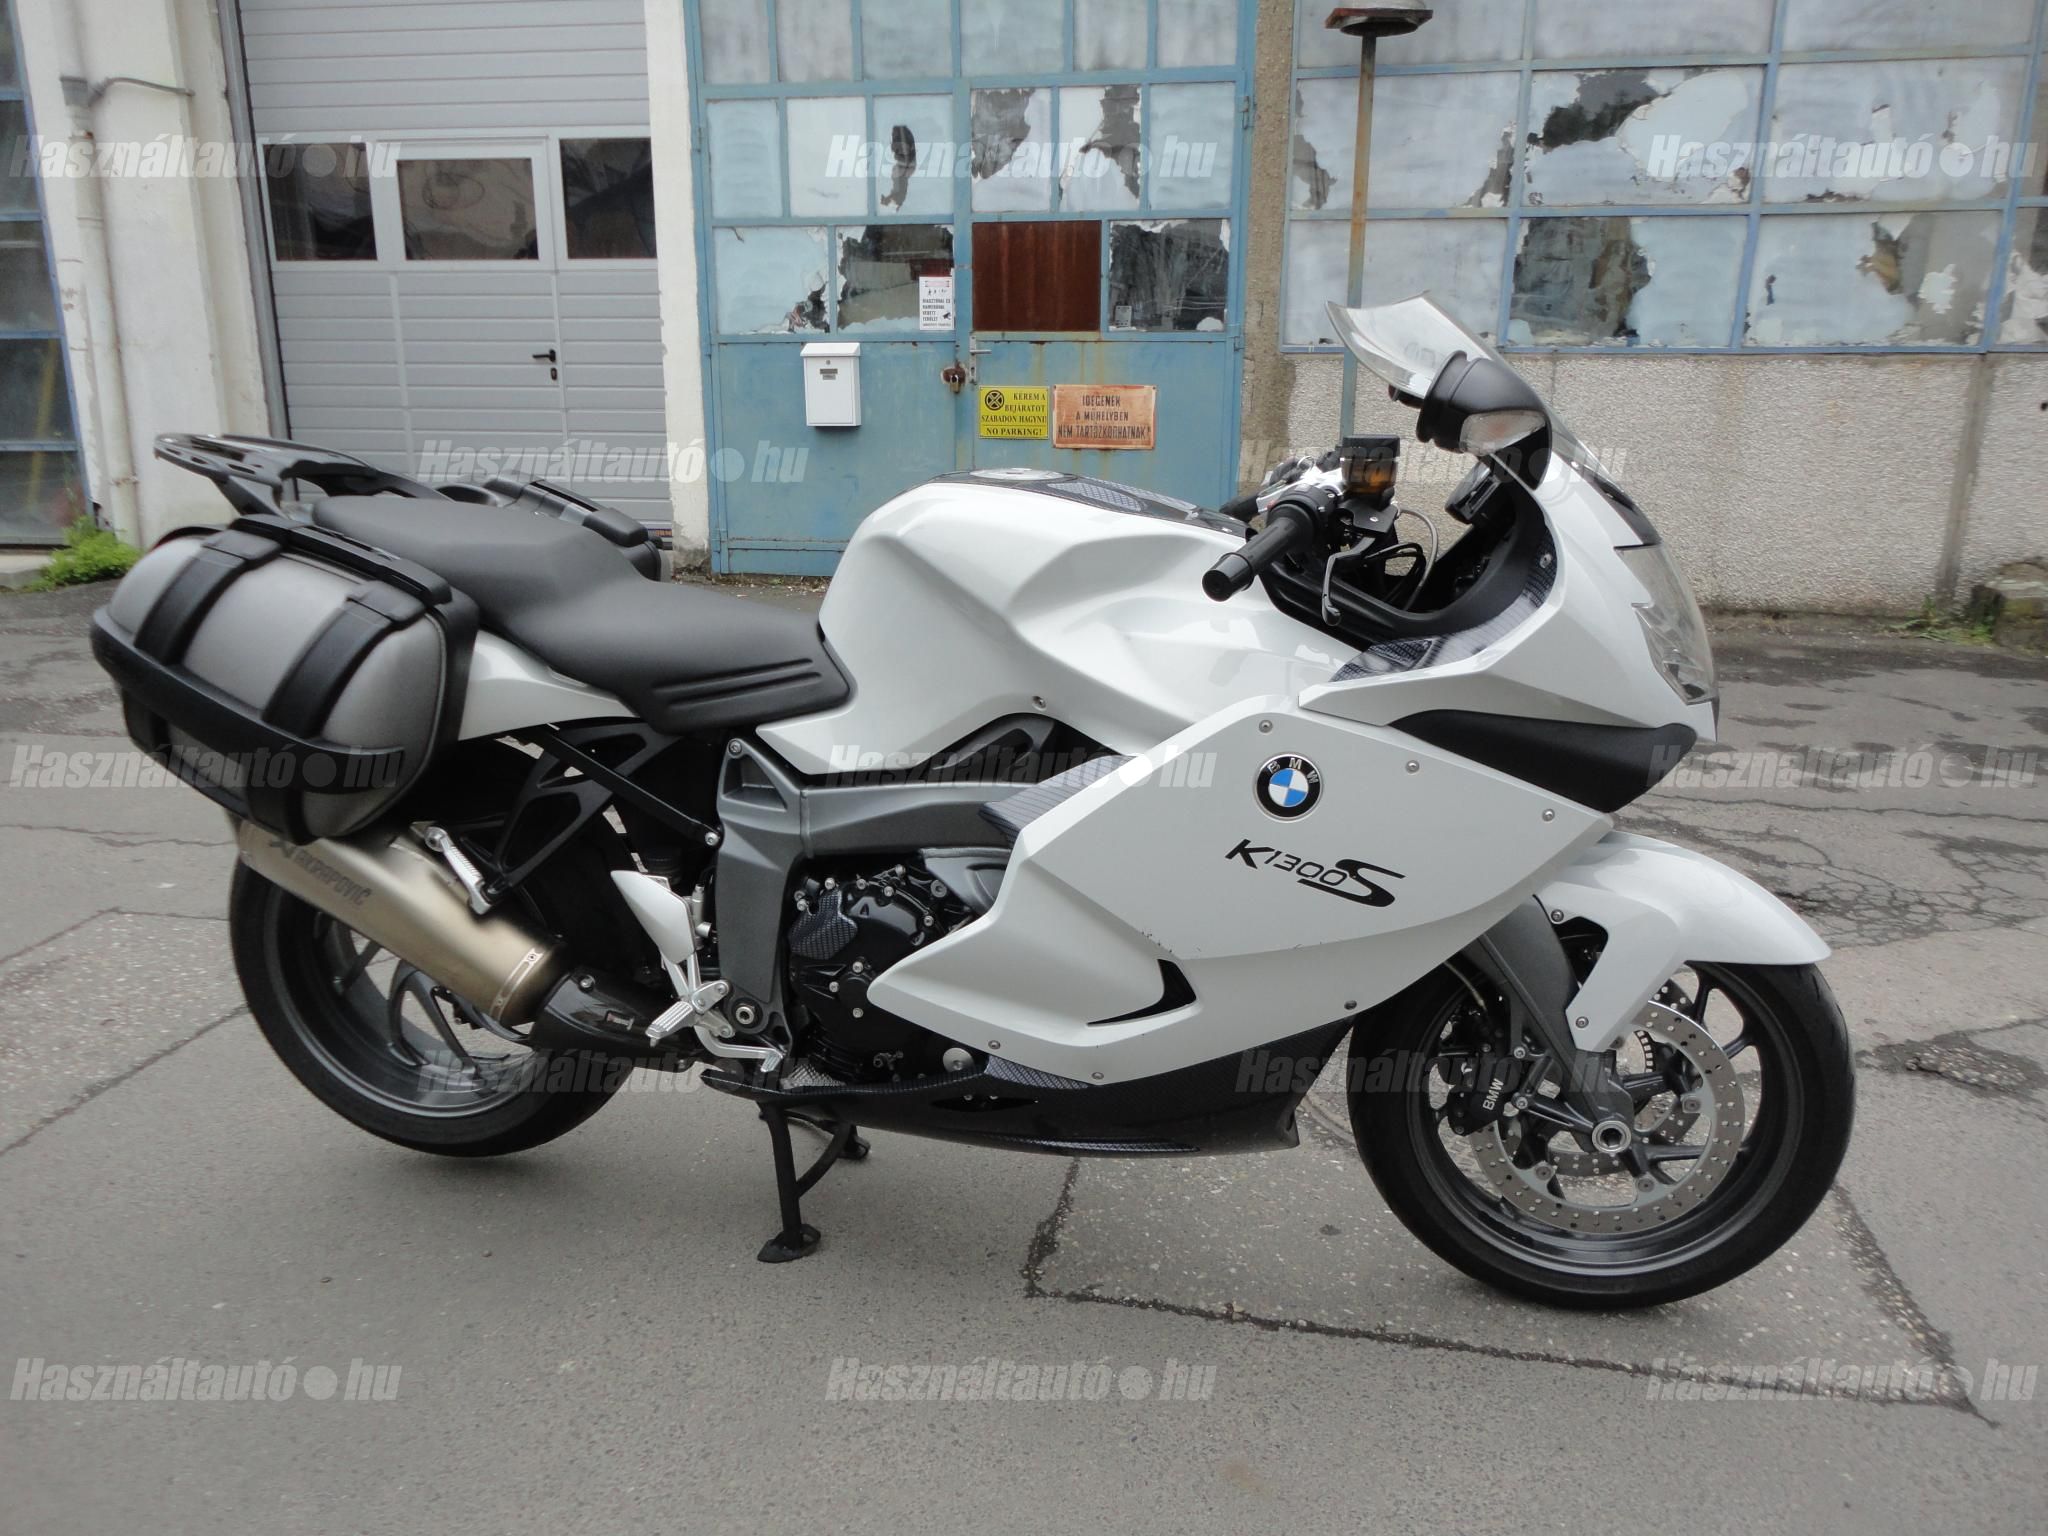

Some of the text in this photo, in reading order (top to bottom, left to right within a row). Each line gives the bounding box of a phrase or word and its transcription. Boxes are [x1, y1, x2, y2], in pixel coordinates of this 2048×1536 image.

[1040, 393, 1046, 401] A
[1082, 394, 1121, 408] IDEGENEK
[981, 414, 1017, 423] SZABADON
[1075, 410, 1081, 421] A
[986, 427, 1042, 437] NO PARKING!
[1057, 423, 1073, 439] NEM
[1267, 757, 1320, 785] BMW
[1225, 838, 1407, 908] K1300S
[1482, 1077, 1505, 1111] BMW
